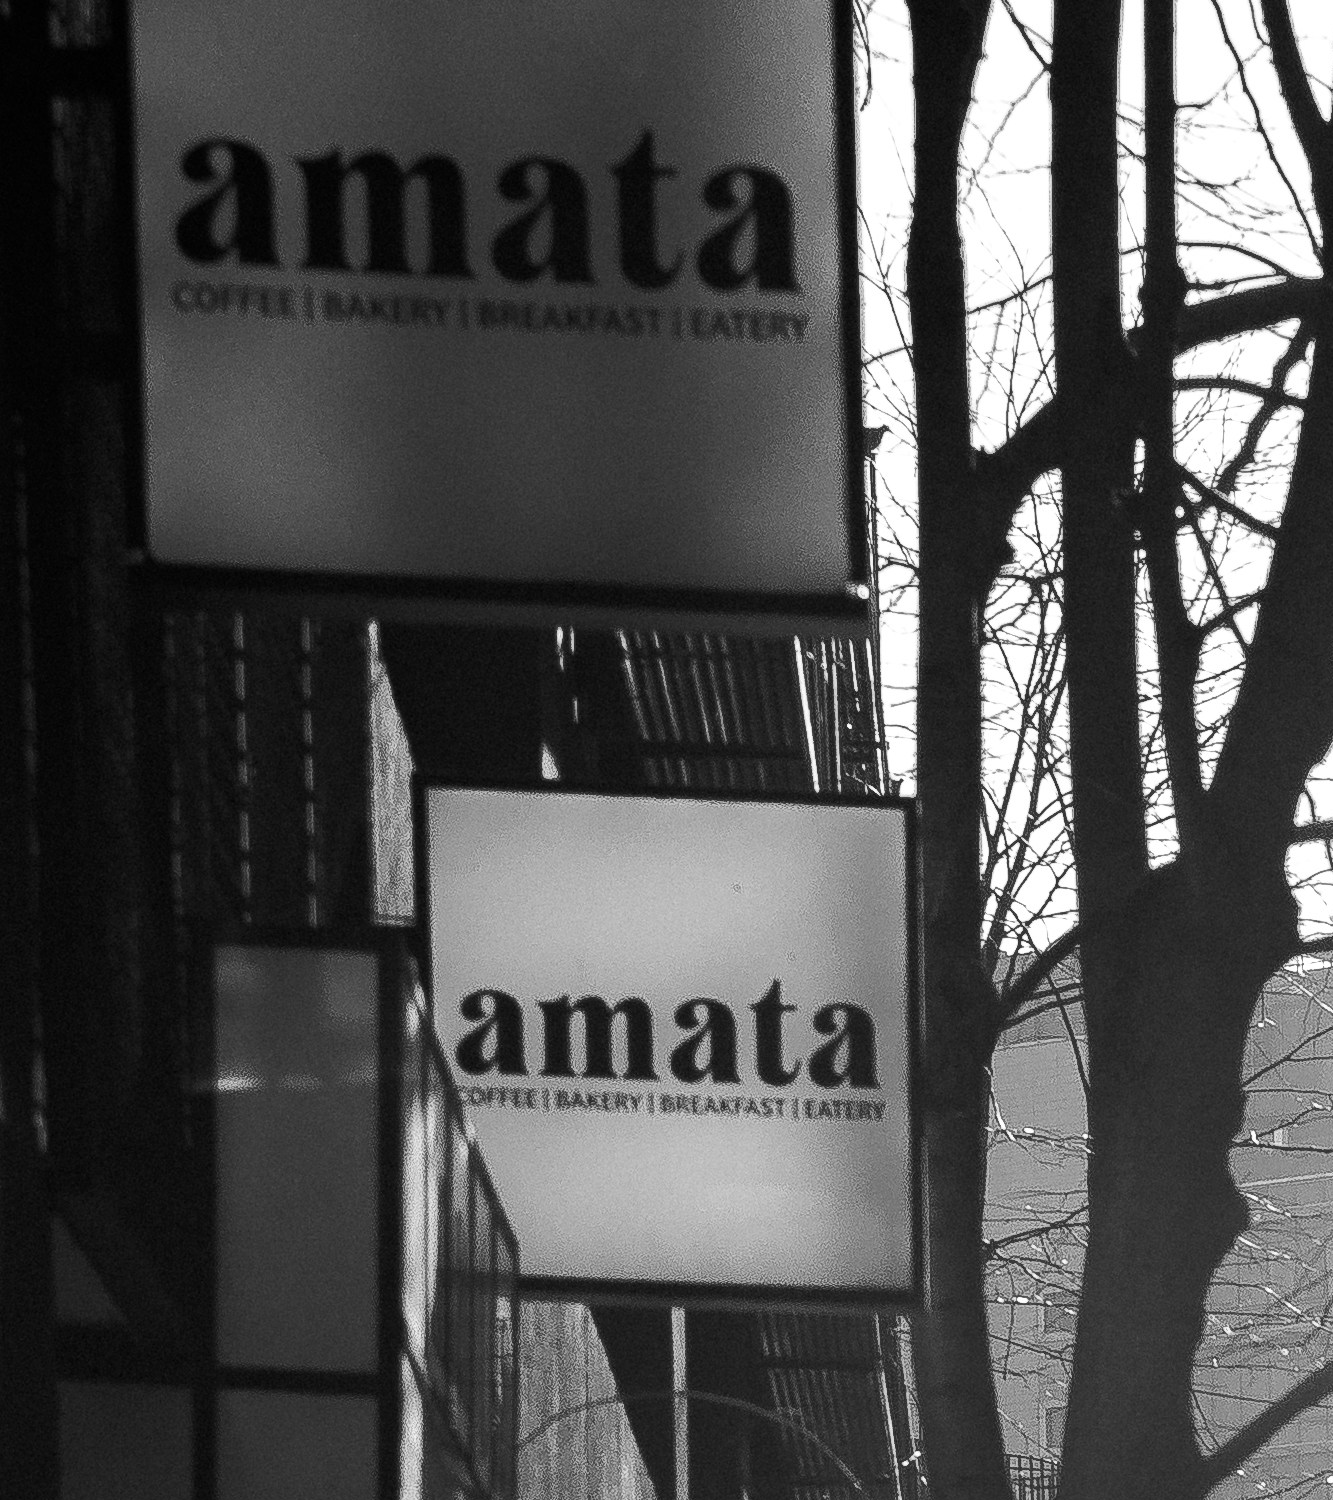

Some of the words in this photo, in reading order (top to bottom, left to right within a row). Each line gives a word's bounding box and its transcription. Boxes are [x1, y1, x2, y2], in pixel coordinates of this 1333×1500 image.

[175, 128, 804, 293] amata
[174, 282, 295, 319] COFFEE
[322, 293, 451, 328] BAKERY
[478, 302, 664, 336] BREAKFAST
[690, 308, 808, 342] EATERY
[455, 978, 881, 1090] amata
[557, 1089, 640, 1113] BAKERY
[660, 1093, 783, 1117] BREAKFAST
[805, 1097, 886, 1121] EATERY
